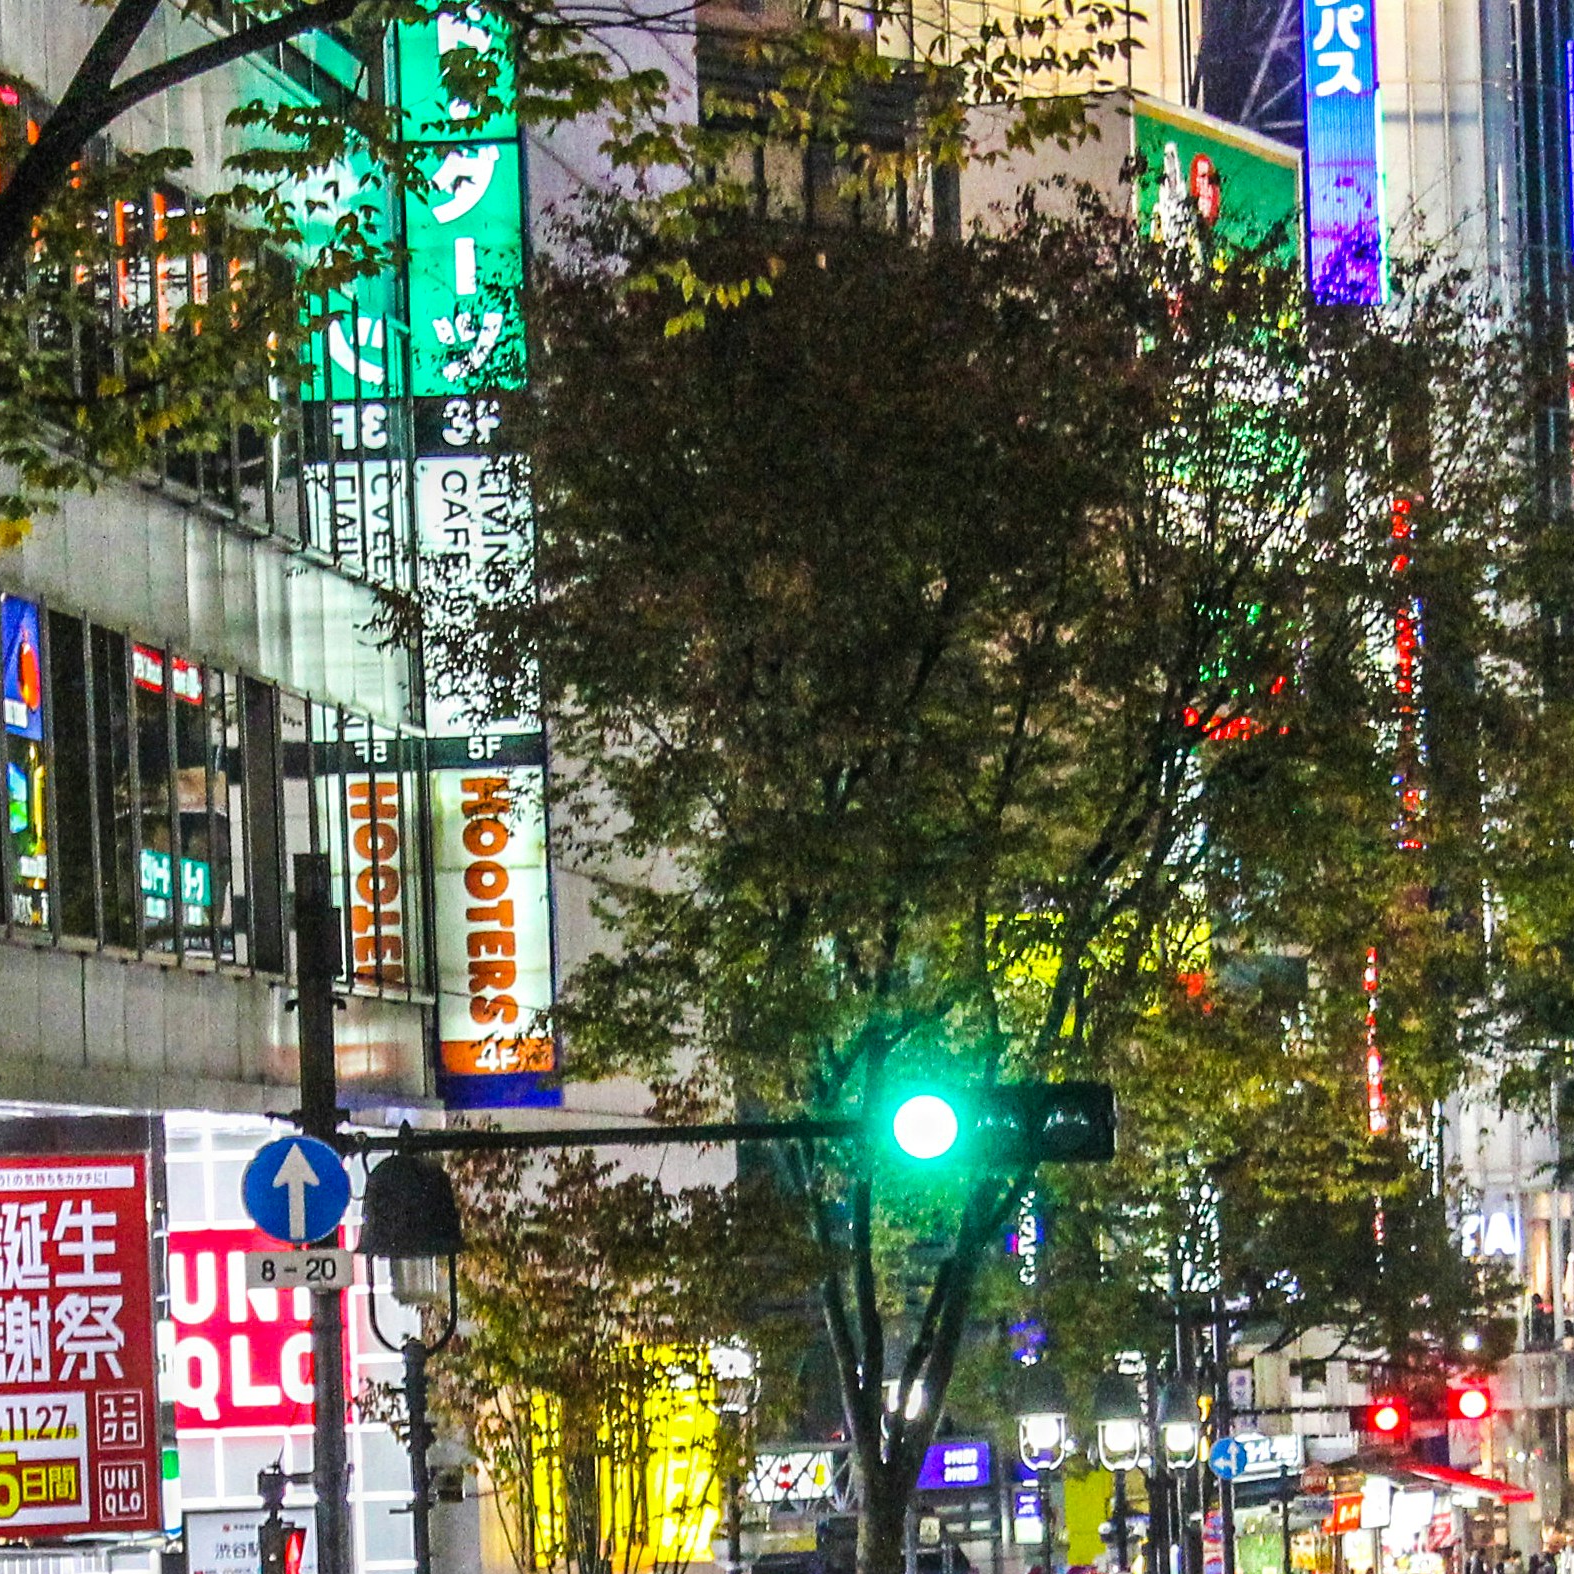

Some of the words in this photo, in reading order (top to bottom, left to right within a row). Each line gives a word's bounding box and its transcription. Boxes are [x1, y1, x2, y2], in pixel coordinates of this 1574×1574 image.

[1312, 0, 1364, 97] パス
[467, 736, 501, 760] 5F
[460, 777, 519, 1026] HOOTERS
[103, 1397, 137, 1419] ユニ
[103, 1420, 138, 1444] クロ
[103, 1468, 139, 1490] UNI
[105, 1492, 142, 1517] QLO
